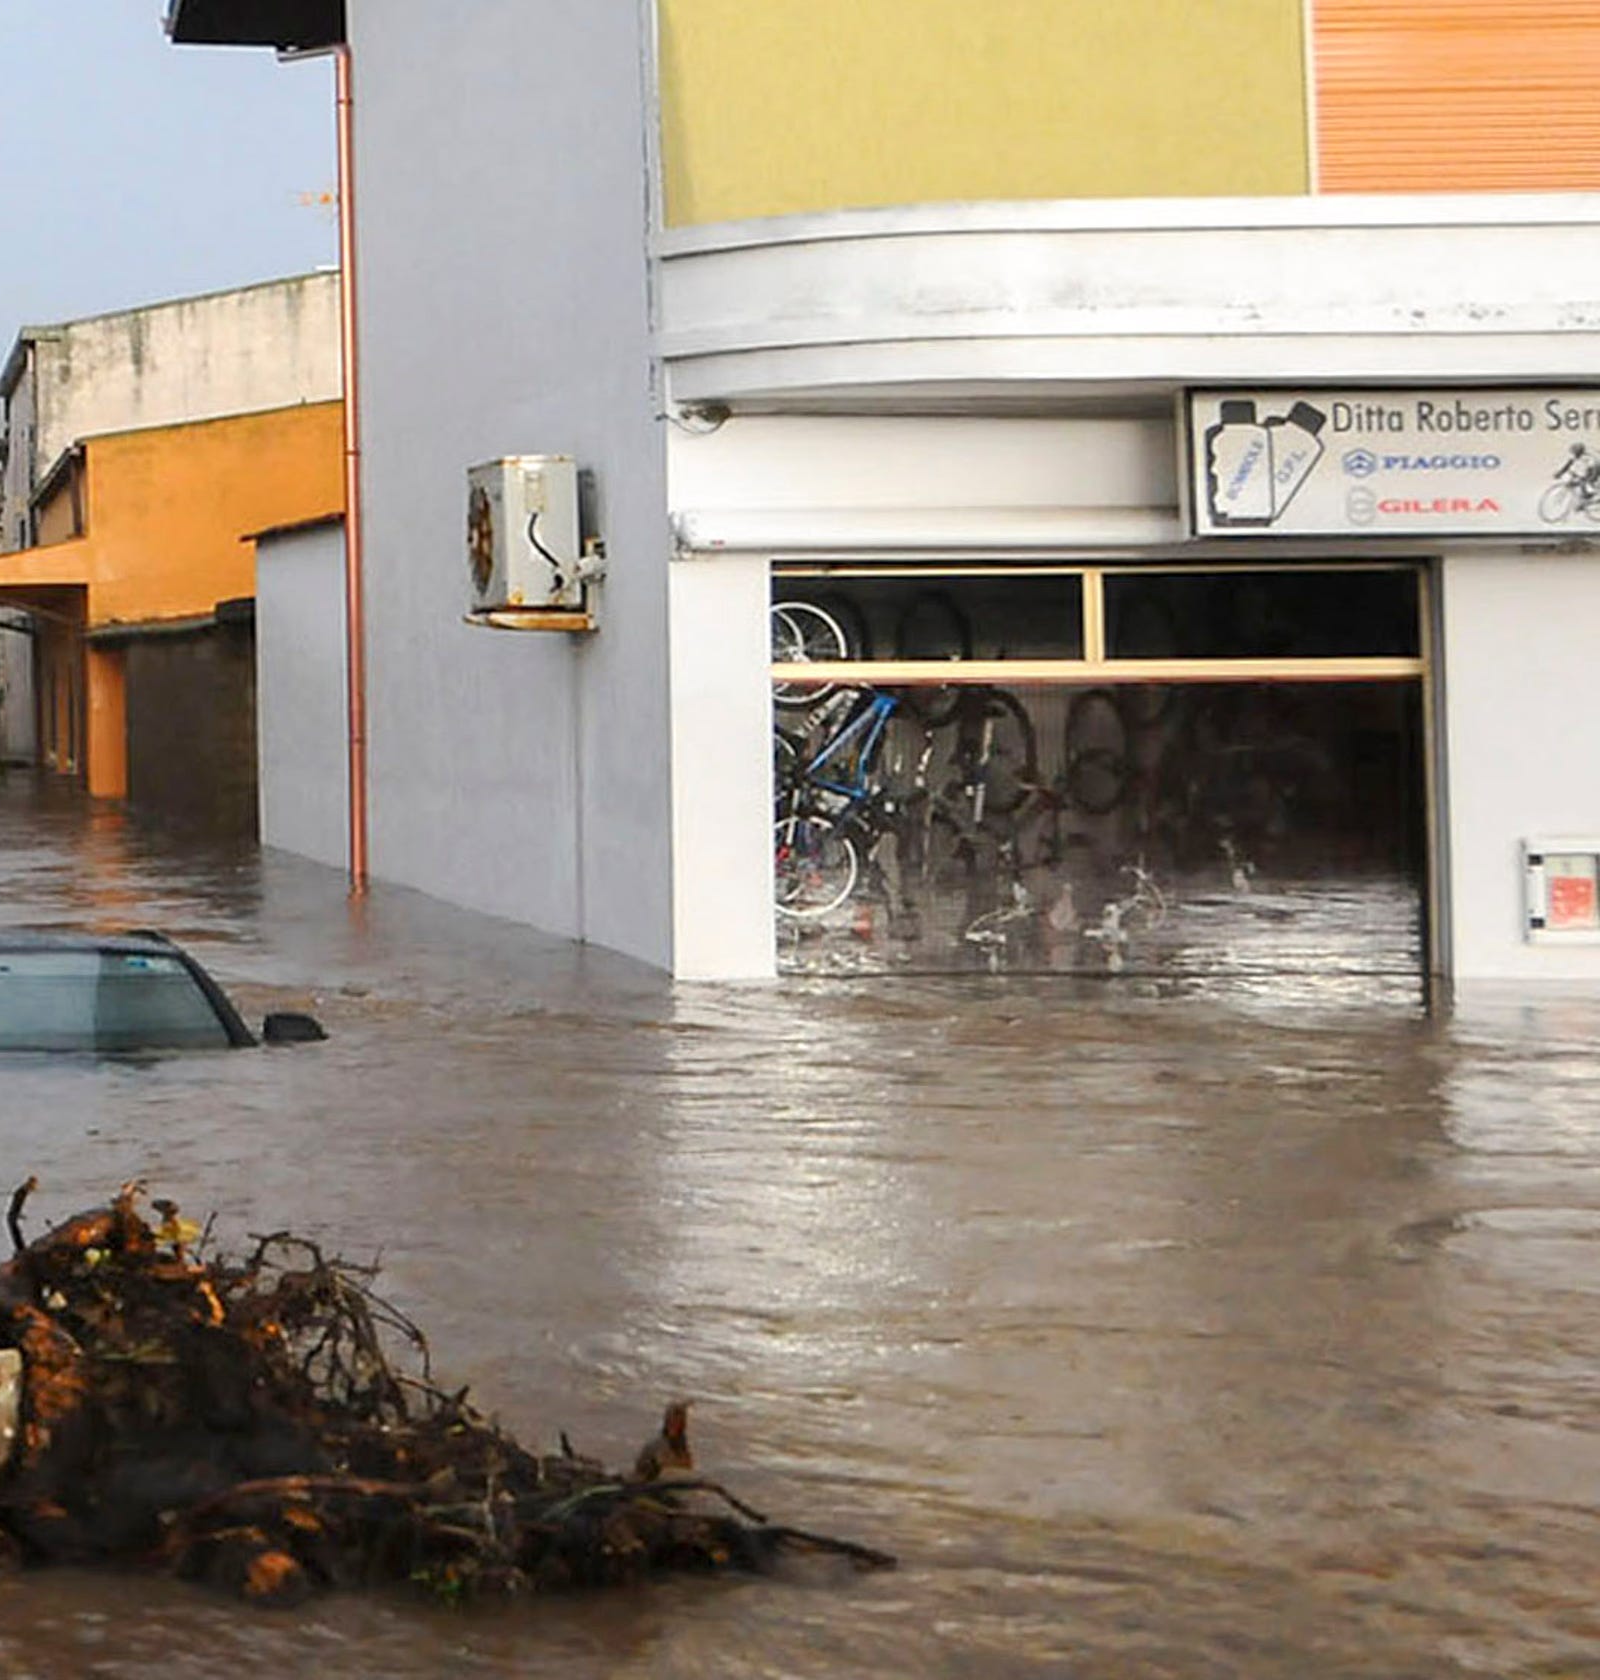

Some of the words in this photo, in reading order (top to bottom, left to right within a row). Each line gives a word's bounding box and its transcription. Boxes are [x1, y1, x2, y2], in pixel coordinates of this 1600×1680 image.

[1332, 401, 1404, 432] Ditta
[1417, 399, 1534, 432] Roberto
[1545, 398, 1600, 432] Ser
[1383, 455, 1501, 470] PIAGGIO
[1377, 498, 1500, 513] GILERA
